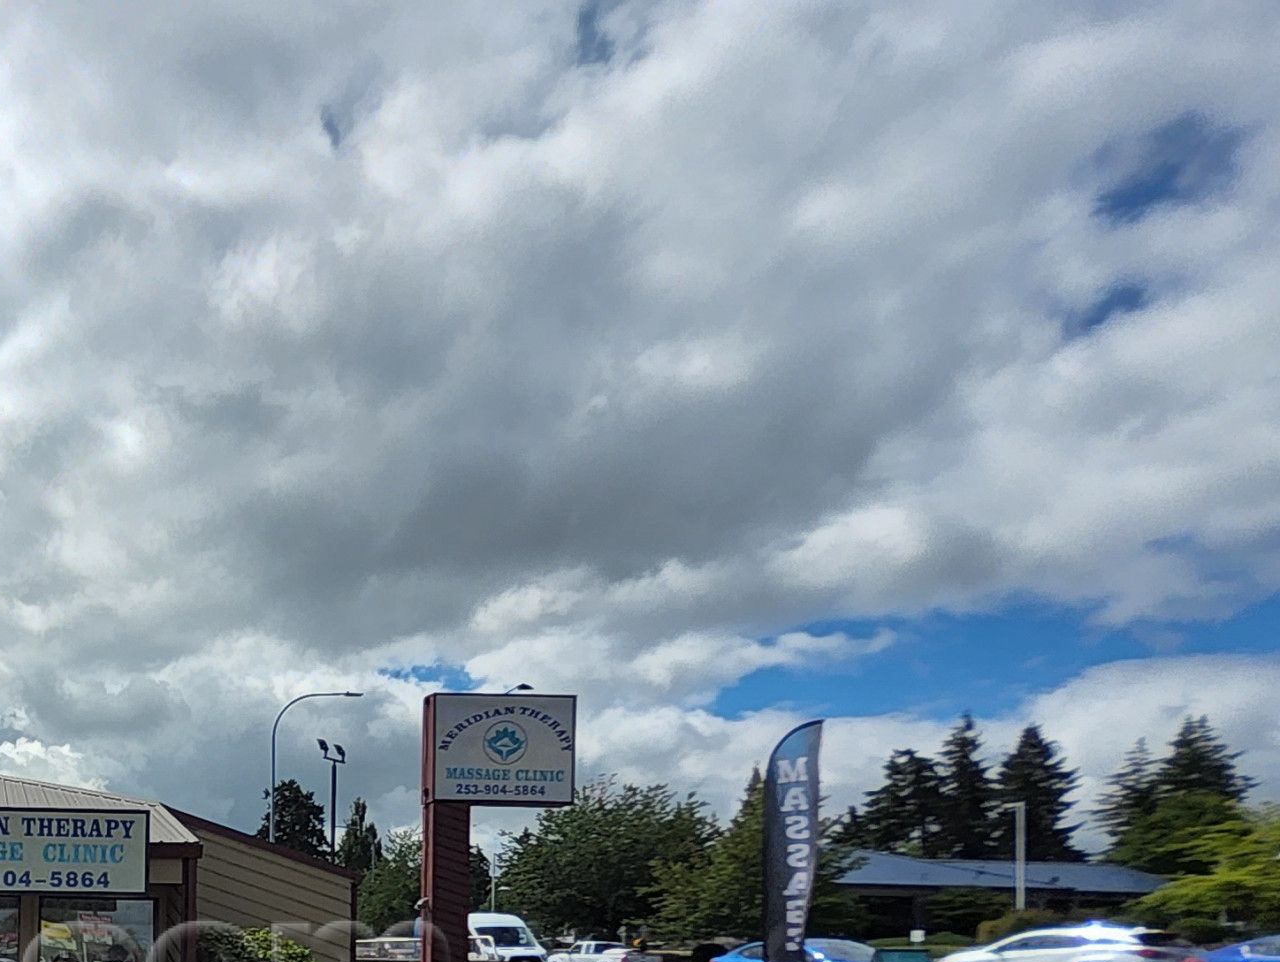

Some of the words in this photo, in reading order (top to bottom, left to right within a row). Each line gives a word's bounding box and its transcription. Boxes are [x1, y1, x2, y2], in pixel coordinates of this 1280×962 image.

[438, 706, 516, 751] MERIDIAN
[519, 706, 572, 752] THERAPY
[445, 767, 511, 781] MASSAGE
[515, 769, 565, 782] CLINIC
[455, 783, 546, 796] 253-904-5864
[22, 817, 135, 839] THERAPY
[42, 843, 125, 864] CLINIC
